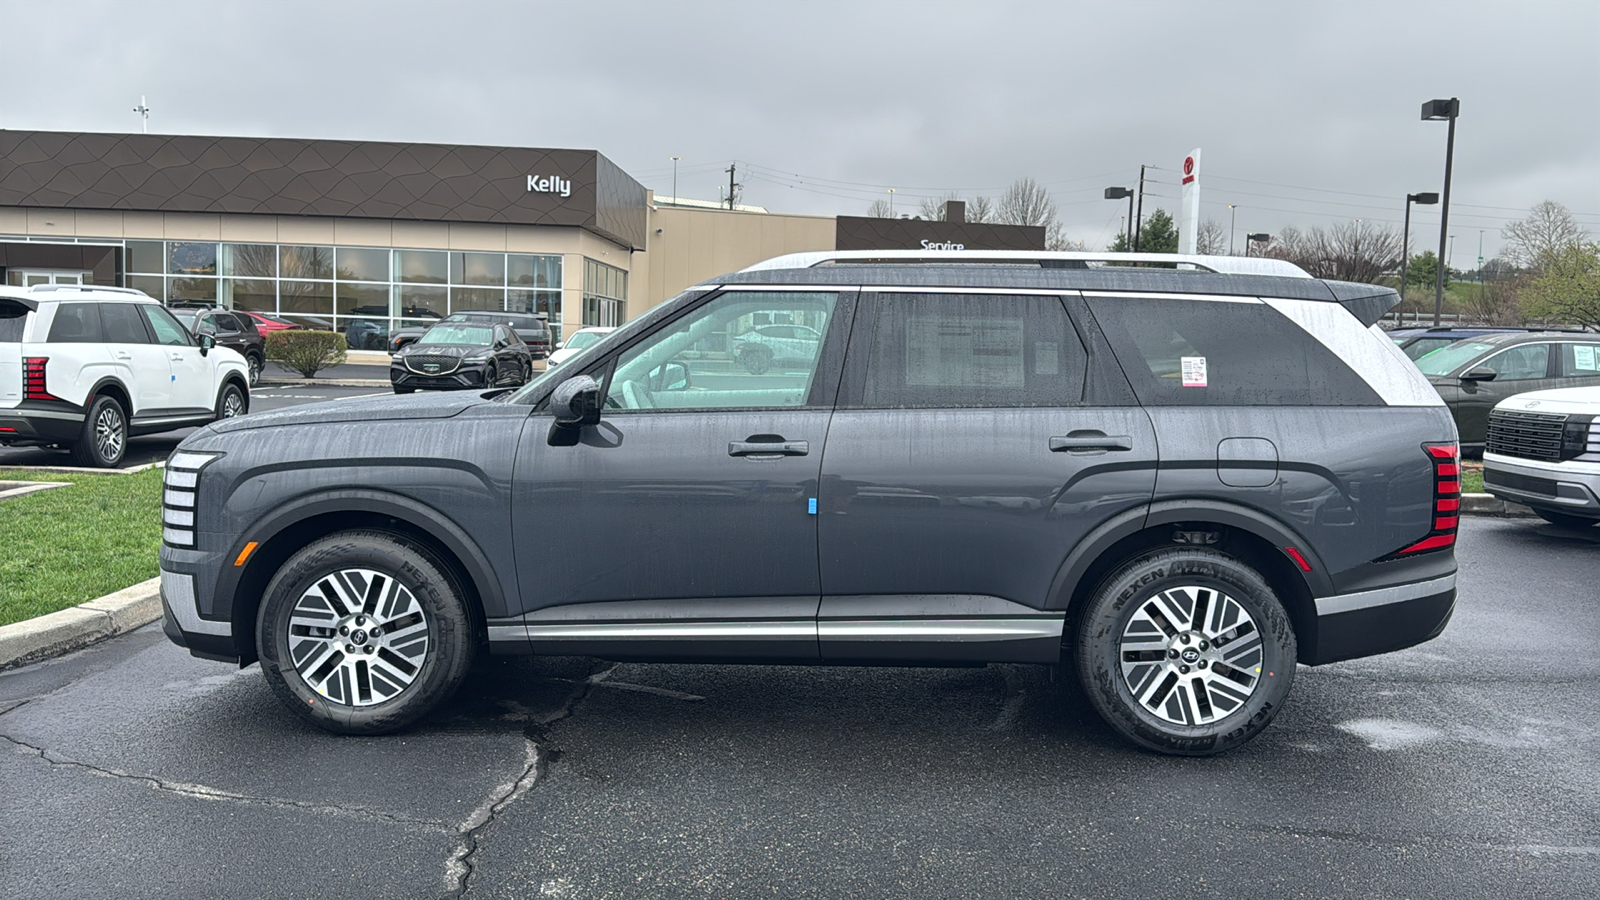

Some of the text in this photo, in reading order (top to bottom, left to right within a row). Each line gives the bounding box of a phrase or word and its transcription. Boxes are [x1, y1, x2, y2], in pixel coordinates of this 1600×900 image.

[527, 174, 571, 197] Kelly
[920, 239, 965, 250] Service
[402, 561, 446, 611] NEXEN
[1112, 568, 1165, 611] NEXEN
[1222, 701, 1273, 741] NEXEN
